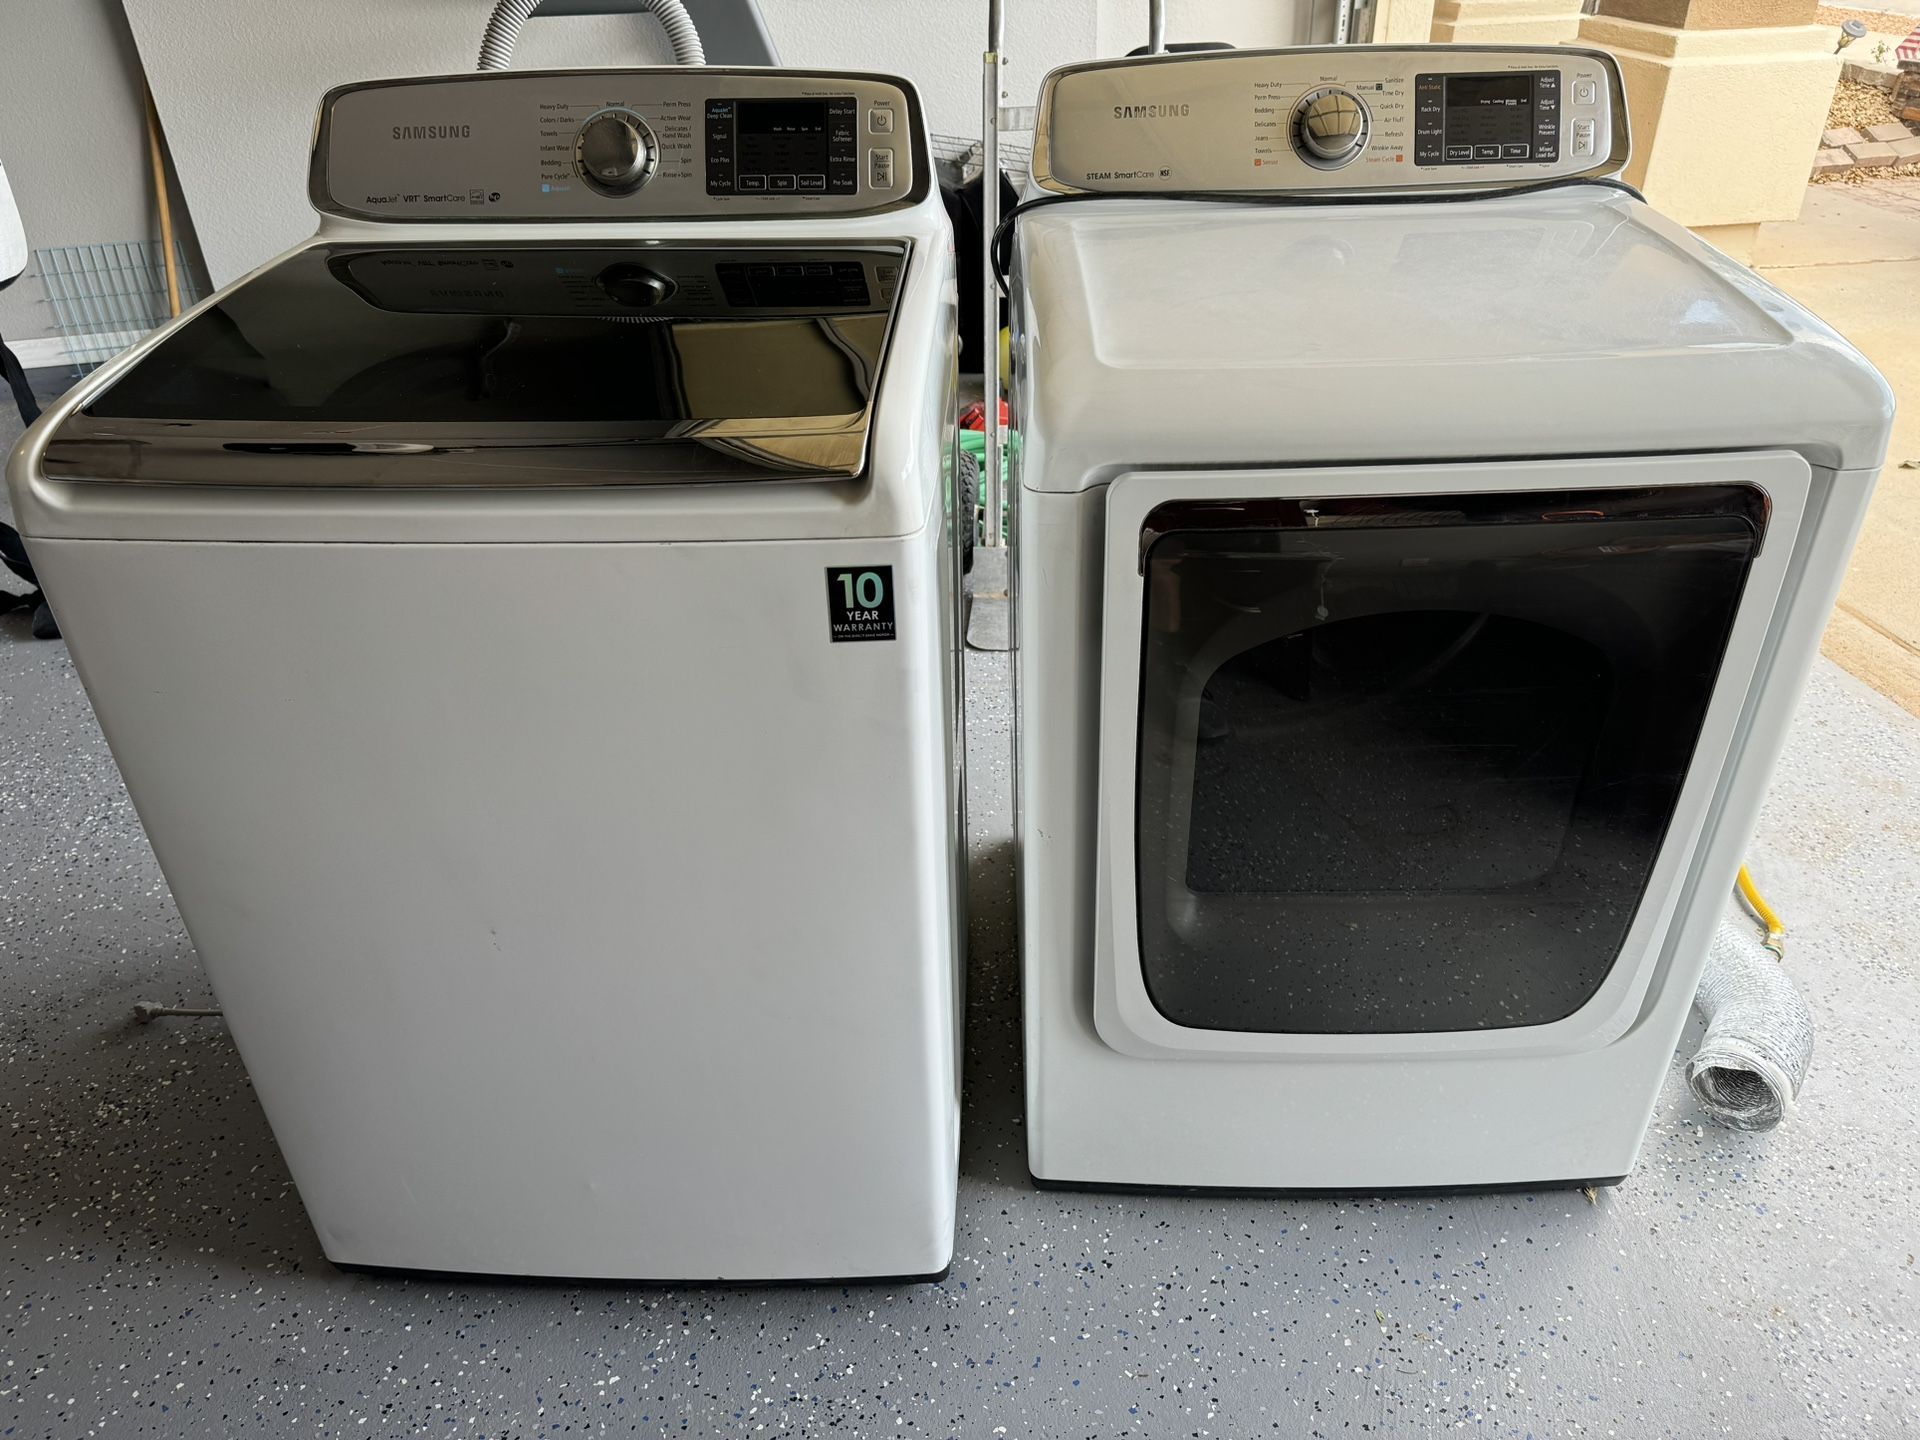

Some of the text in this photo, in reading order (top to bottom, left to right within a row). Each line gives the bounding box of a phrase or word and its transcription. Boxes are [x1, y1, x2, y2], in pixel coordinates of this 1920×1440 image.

[1113, 104, 1190, 119] SAMSUNG
[392, 125, 471, 140] SAMSUNG
[1086, 171, 1154, 180] STEAM SmartCare
[423, 194, 466, 203] SmartCare
[836, 572, 884, 608] 10
[846, 610, 879, 621] YEAR
[833, 622, 893, 632] WARRANTY
